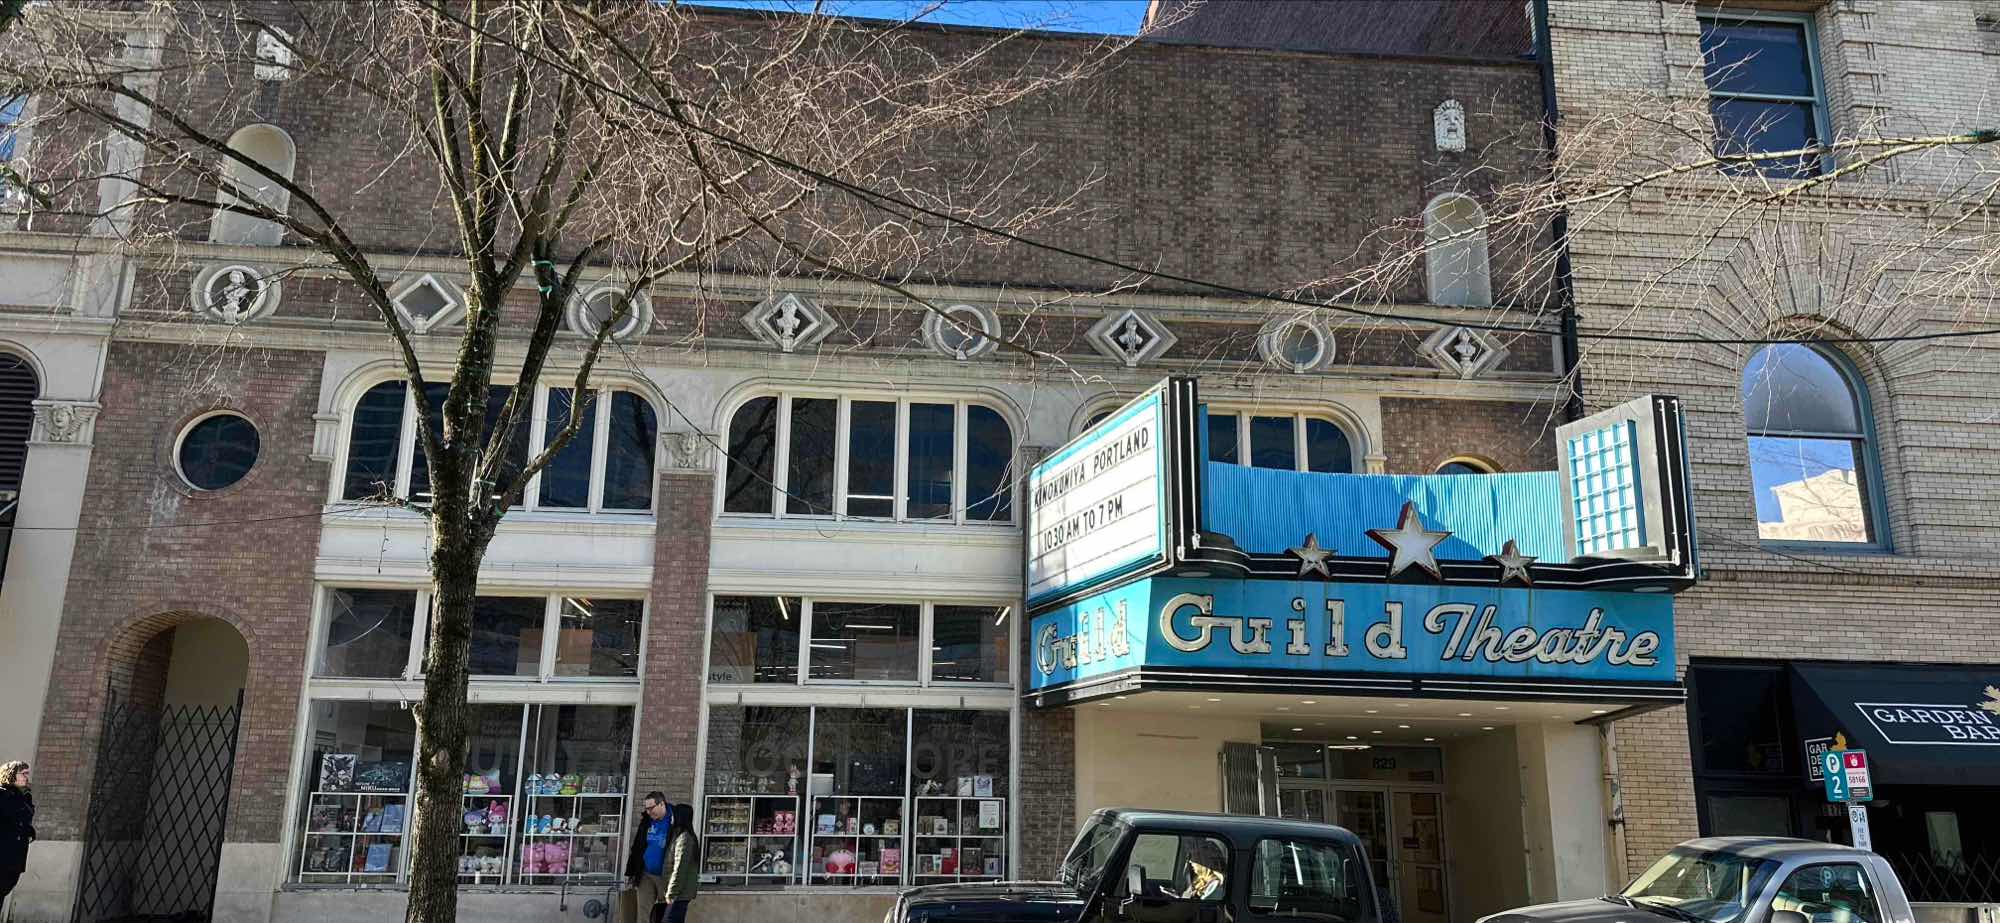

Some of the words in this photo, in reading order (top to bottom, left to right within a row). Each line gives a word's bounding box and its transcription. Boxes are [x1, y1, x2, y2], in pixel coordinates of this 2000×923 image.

[1034, 463, 1086, 508] KINOKUNIYA
[1093, 427, 1149, 474] PORTLAND
[1066, 515, 1080, 541] AM
[1083, 509, 1095, 534] TO
[1099, 504, 1105, 525] 7
[1108, 495, 1123, 520] PM
[1036, 598, 1130, 676] Guild
[1160, 592, 1407, 659] Guild
[1423, 602, 1660, 666] Theatre
[1873, 709, 1992, 724] GARDEN
[1943, 725, 2000, 739] BAR
[1809, 743, 1828, 753] GAR
[1832, 776, 1842, 793] 2
